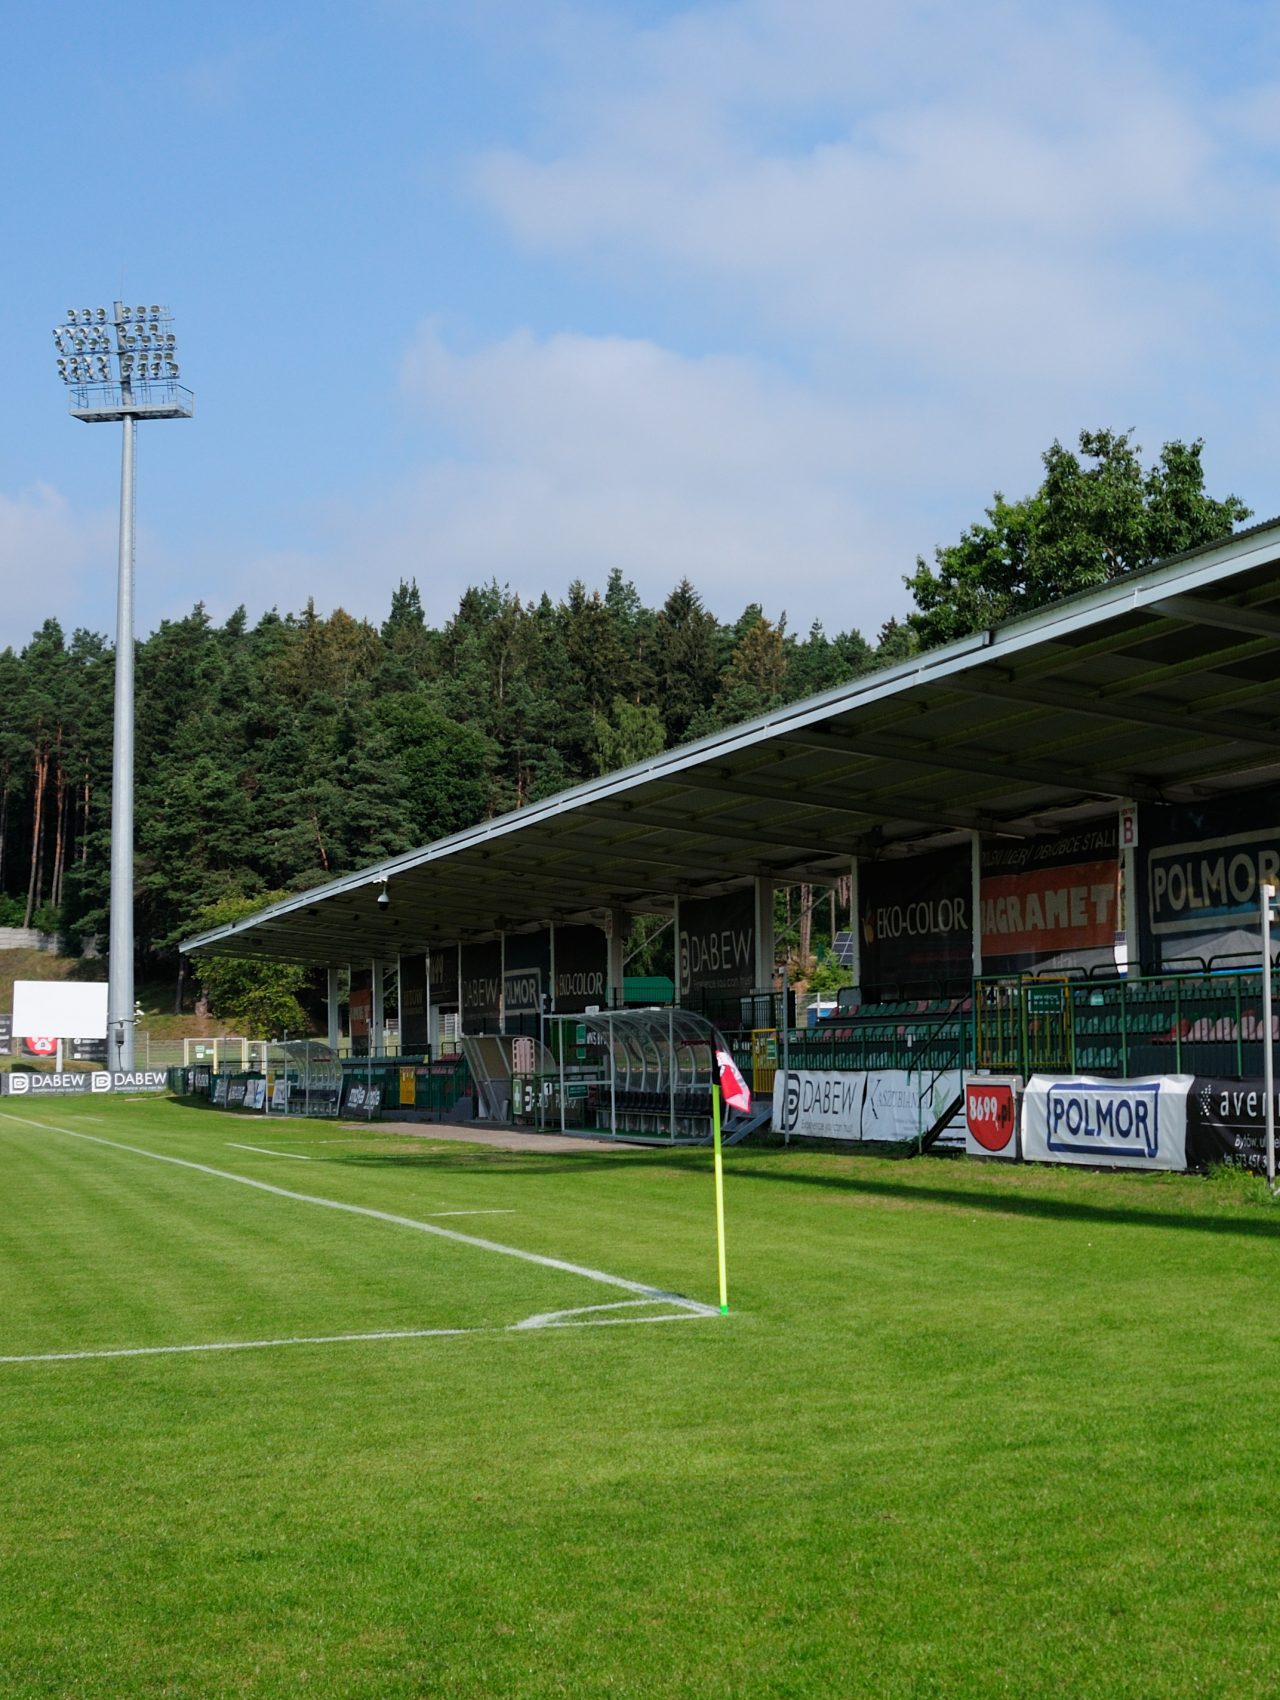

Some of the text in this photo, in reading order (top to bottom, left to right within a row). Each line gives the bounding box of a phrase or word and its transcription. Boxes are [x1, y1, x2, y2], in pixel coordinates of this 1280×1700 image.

[1124, 816, 1134, 844] B
[877, 897, 968, 939] EKO-COLOR
[691, 928, 752, 973] DABEW
[462, 977, 499, 1008] DABEW
[560, 972, 603, 996] EKO-COLOR
[32, 1074, 85, 1088] DABEW
[114, 1072, 167, 1085] DABEW
[545, 1083, 550, 1094] 1
[803, 1080, 857, 1115] DABEW
[1053, 1098, 1149, 1139] POLMOR
